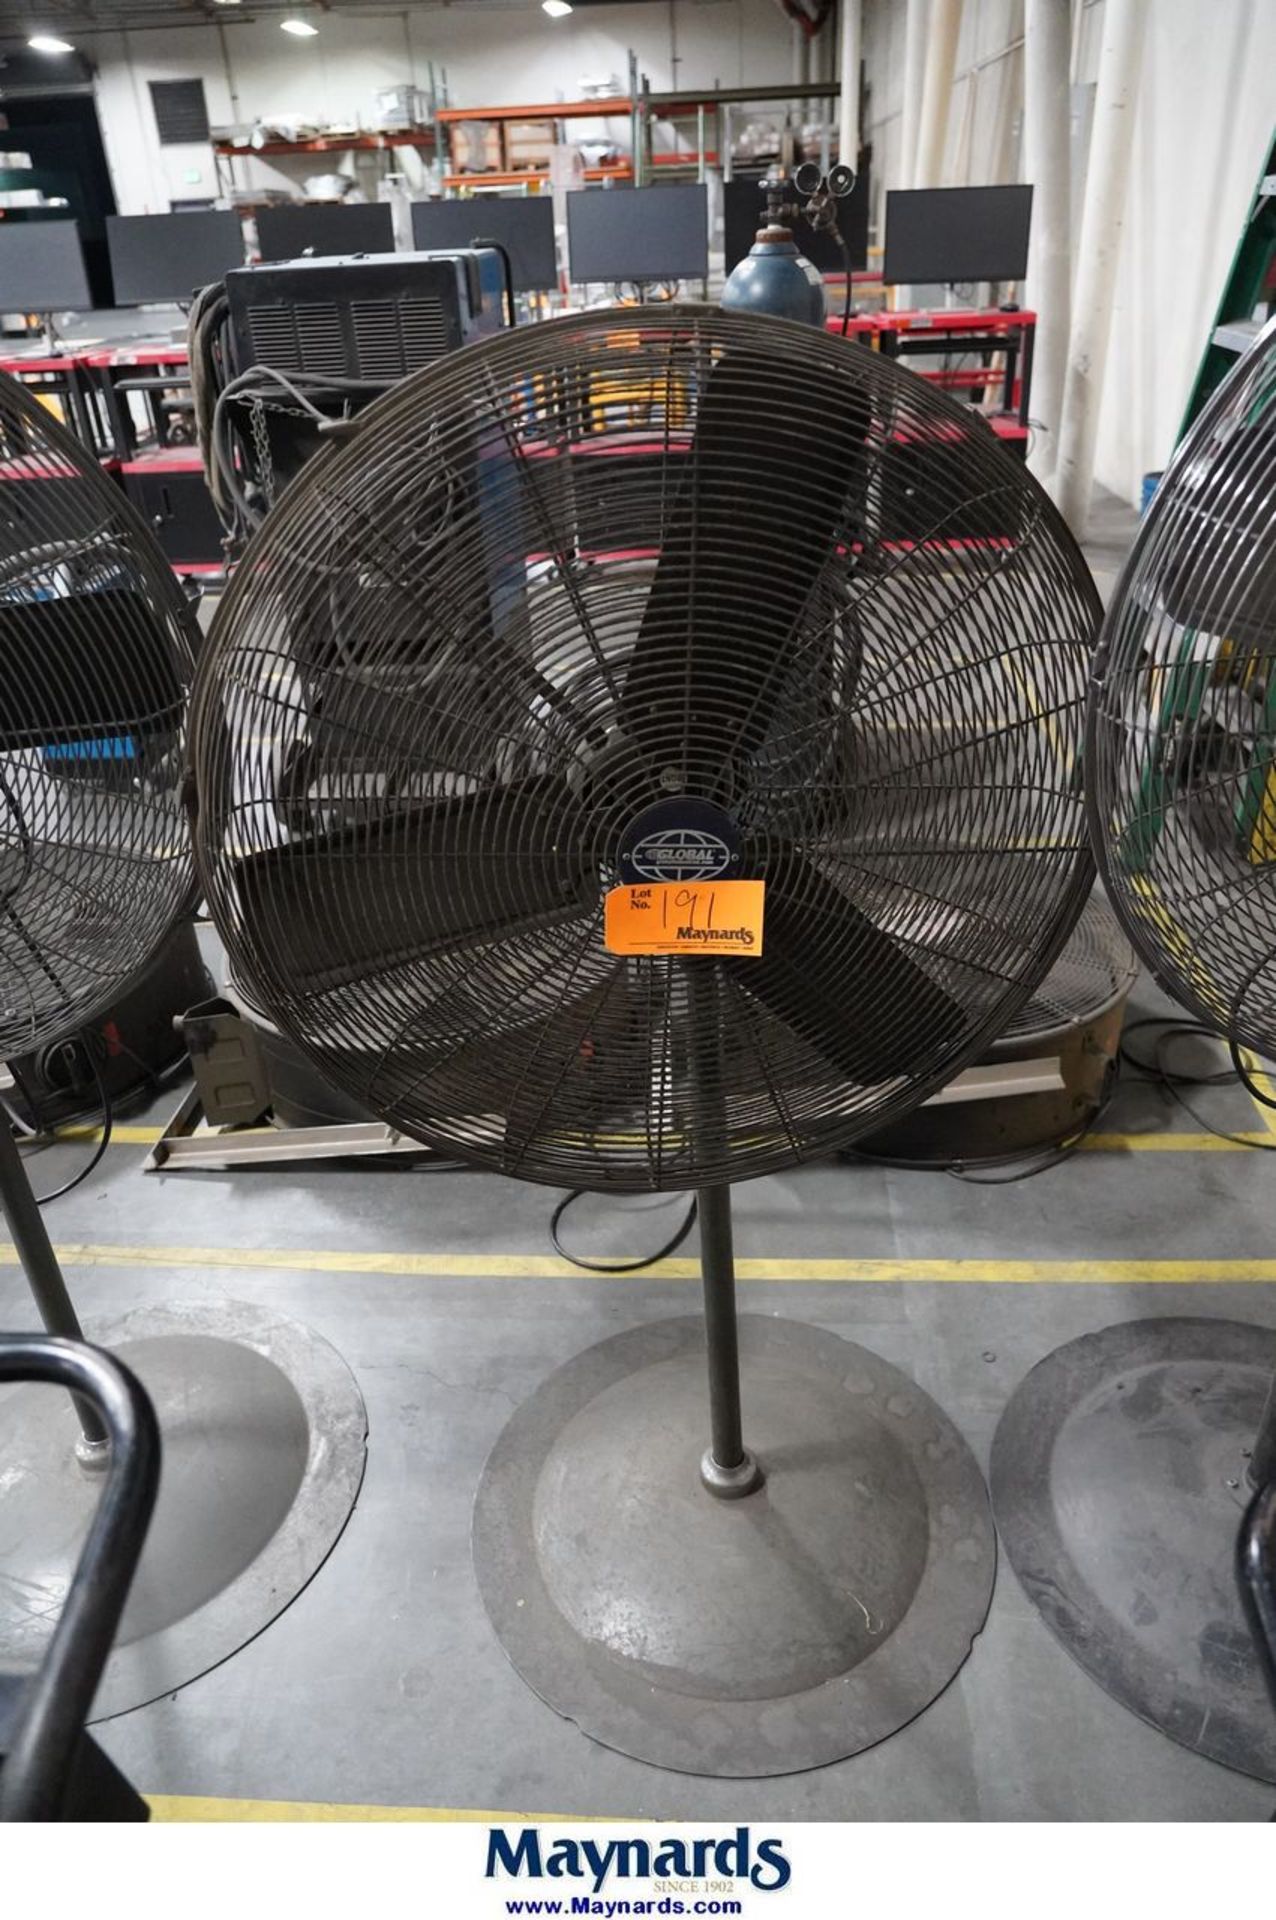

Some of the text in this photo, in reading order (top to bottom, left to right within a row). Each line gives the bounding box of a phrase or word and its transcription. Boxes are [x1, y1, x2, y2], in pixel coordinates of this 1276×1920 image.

[657, 849, 714, 860] GLOBAL
[630, 889, 652, 899] Lot
[630, 900, 651, 910] No.
[663, 889, 715, 929] 191
[676, 926, 754, 945] Maynards
